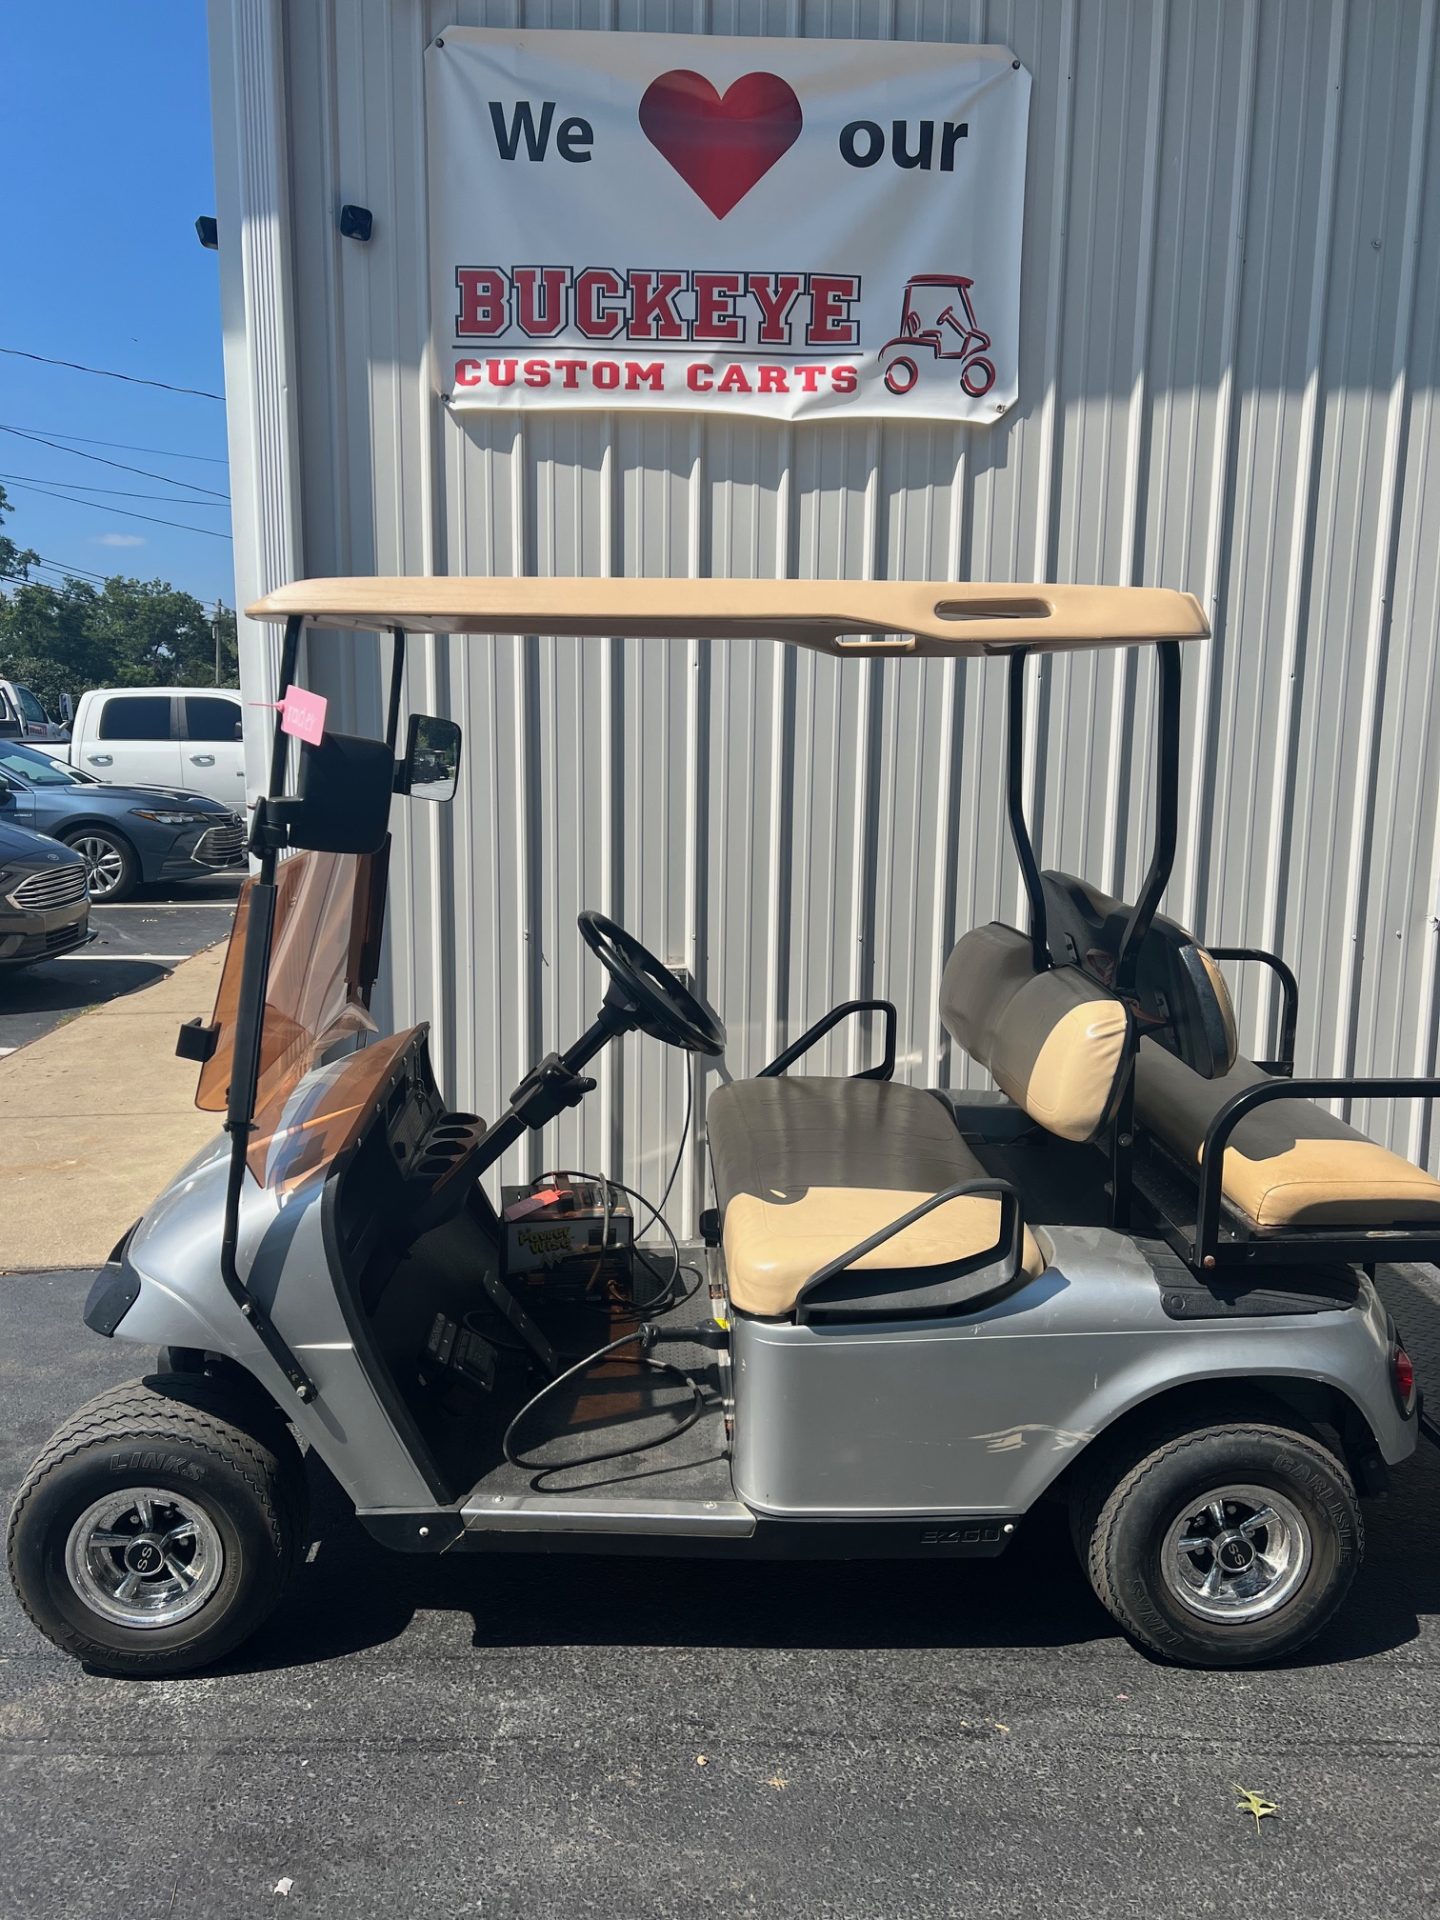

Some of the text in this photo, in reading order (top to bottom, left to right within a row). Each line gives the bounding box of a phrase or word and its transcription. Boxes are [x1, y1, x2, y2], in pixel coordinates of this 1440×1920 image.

[489, 100, 969, 172] We our
[454, 264, 862, 347] BUCKEYE
[454, 358, 859, 395] CUSTOM CARTS
[110, 1451, 206, 1481] LINKS
[137, 1545, 153, 1571] SS
